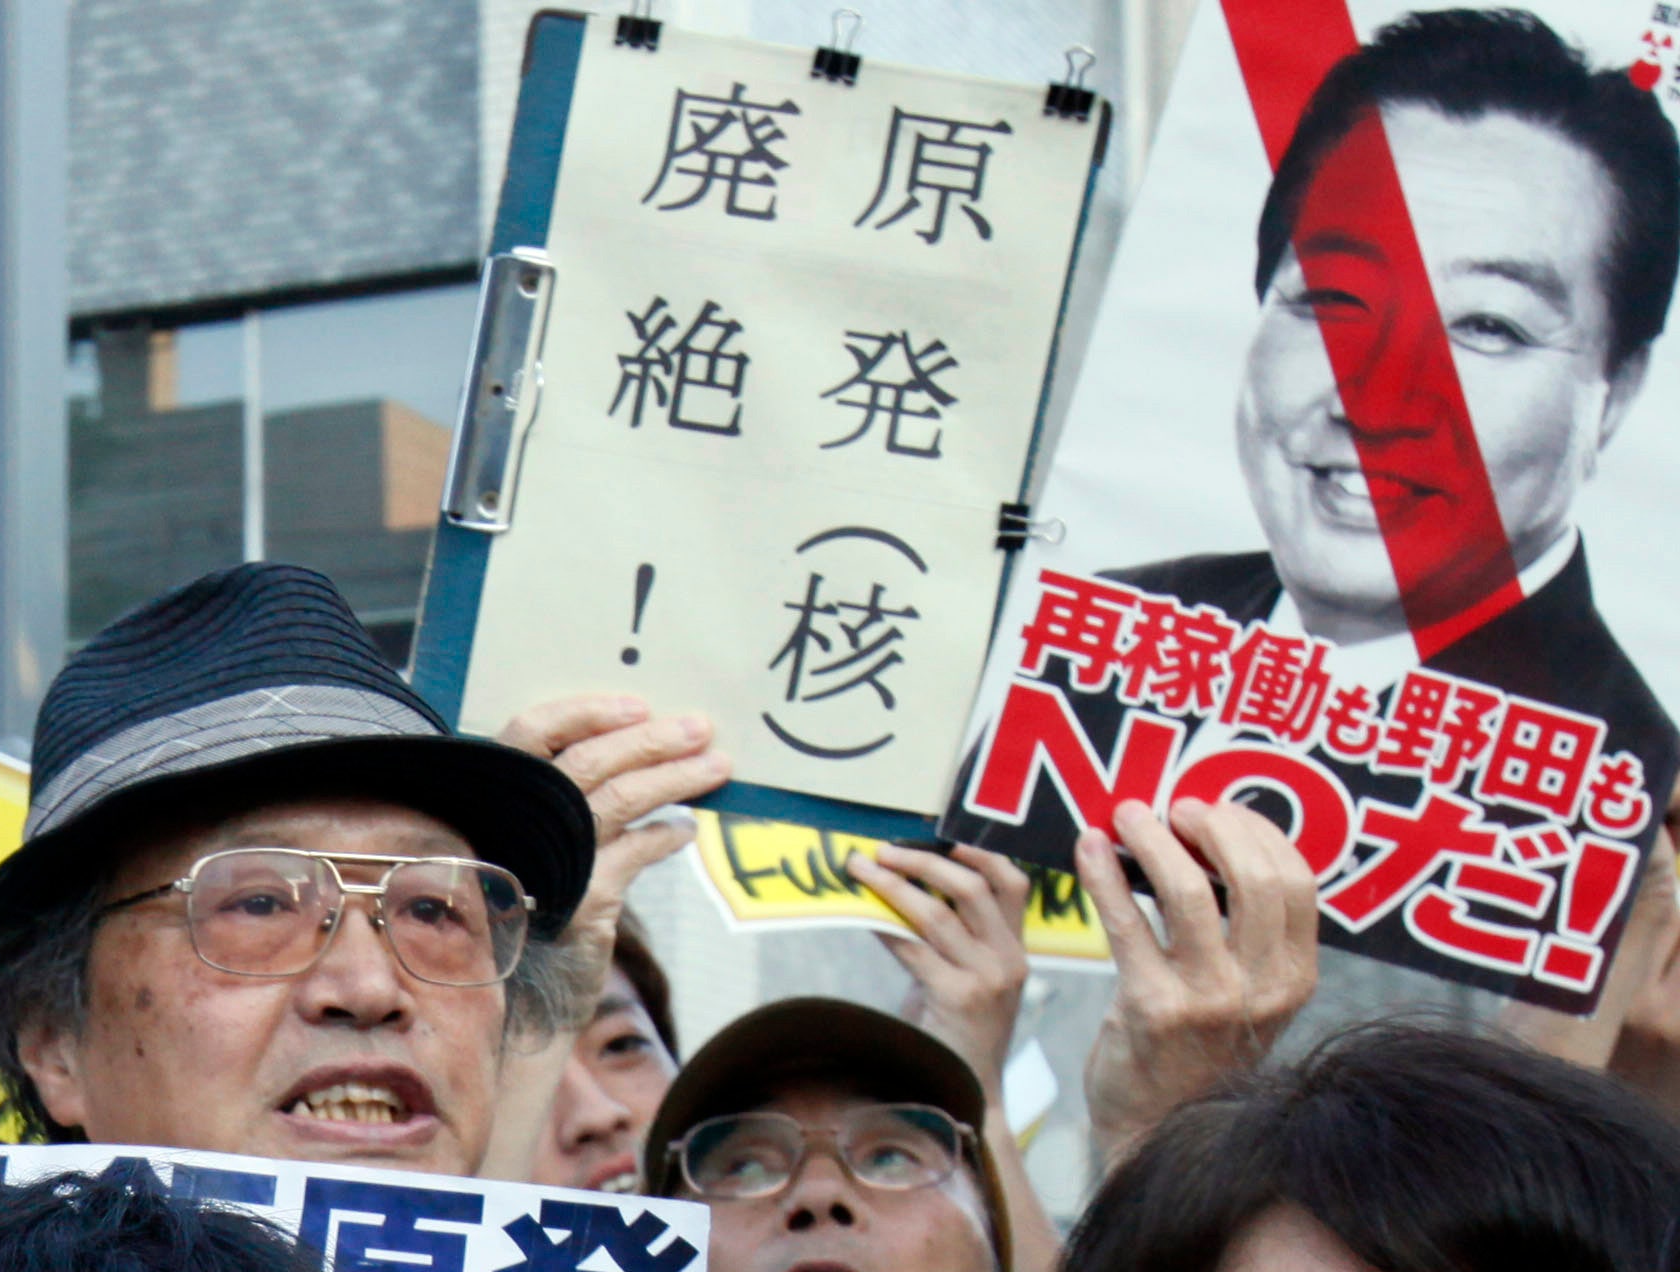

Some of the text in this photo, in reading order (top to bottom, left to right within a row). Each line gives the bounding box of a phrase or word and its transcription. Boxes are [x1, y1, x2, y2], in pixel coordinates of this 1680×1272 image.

[1021, 568, 1649, 836] 再稼働も野田も
